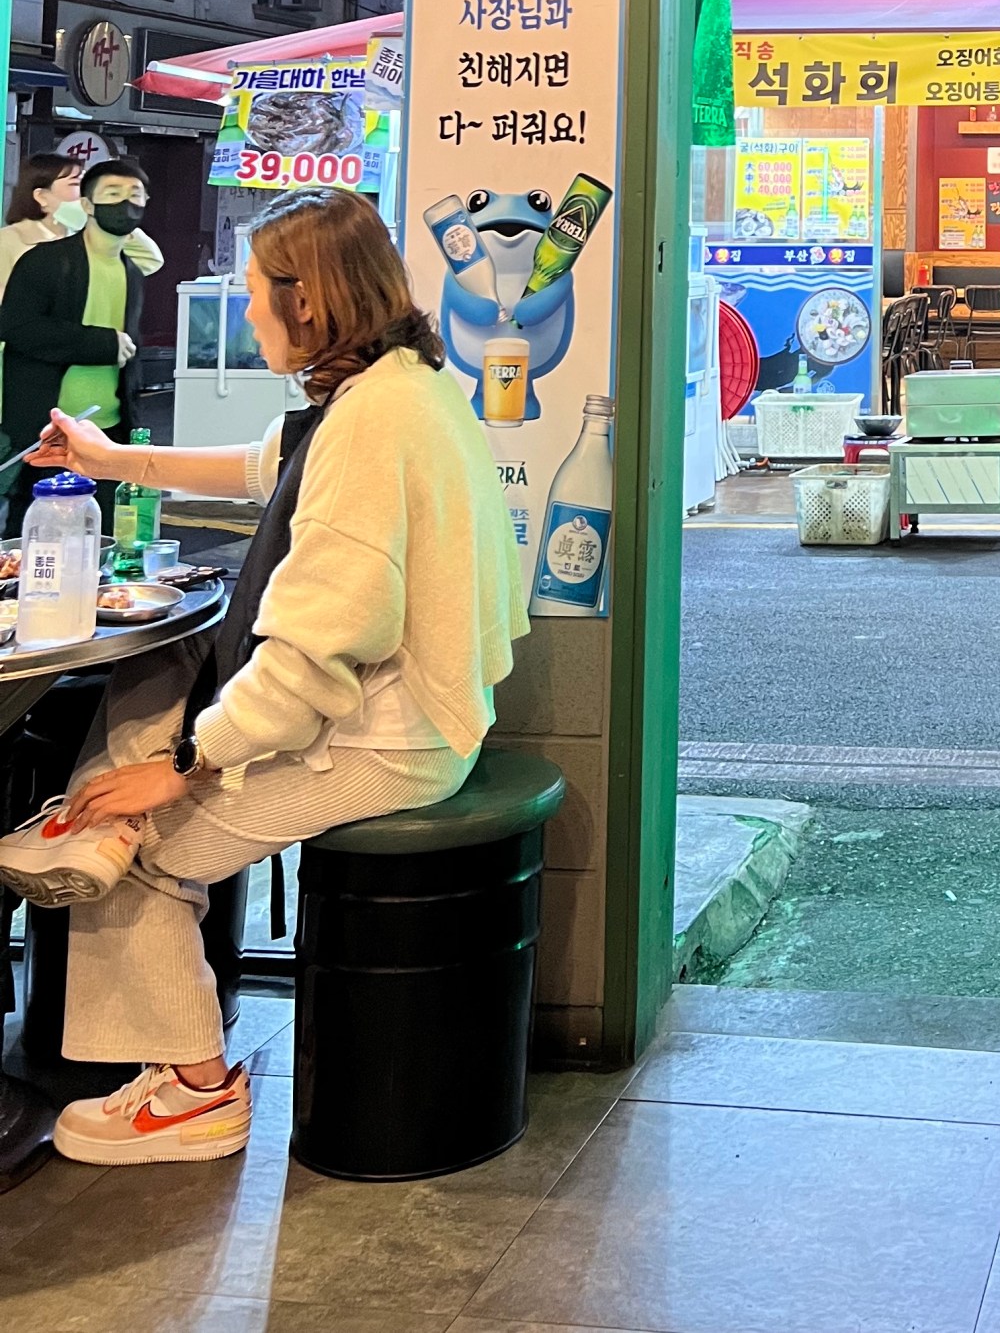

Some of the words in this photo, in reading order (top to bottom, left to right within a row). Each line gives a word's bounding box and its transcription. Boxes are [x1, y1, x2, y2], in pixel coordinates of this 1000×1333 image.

[734, 41, 775, 61] 직송
[233, 68, 326, 90] 가을대하
[457, 51, 570, 89] 친해지면
[747, 60, 899, 106] 석화회
[438, 110, 483, 145] 다~
[491, 109, 587, 146] 퍼줘요!
[236, 151, 363, 186] 39,000
[555, 216, 587, 243] TERRA
[784, 249, 809, 263] 부산
[489, 365, 523, 379] TERRA
[496, 462, 529, 487] RRA
